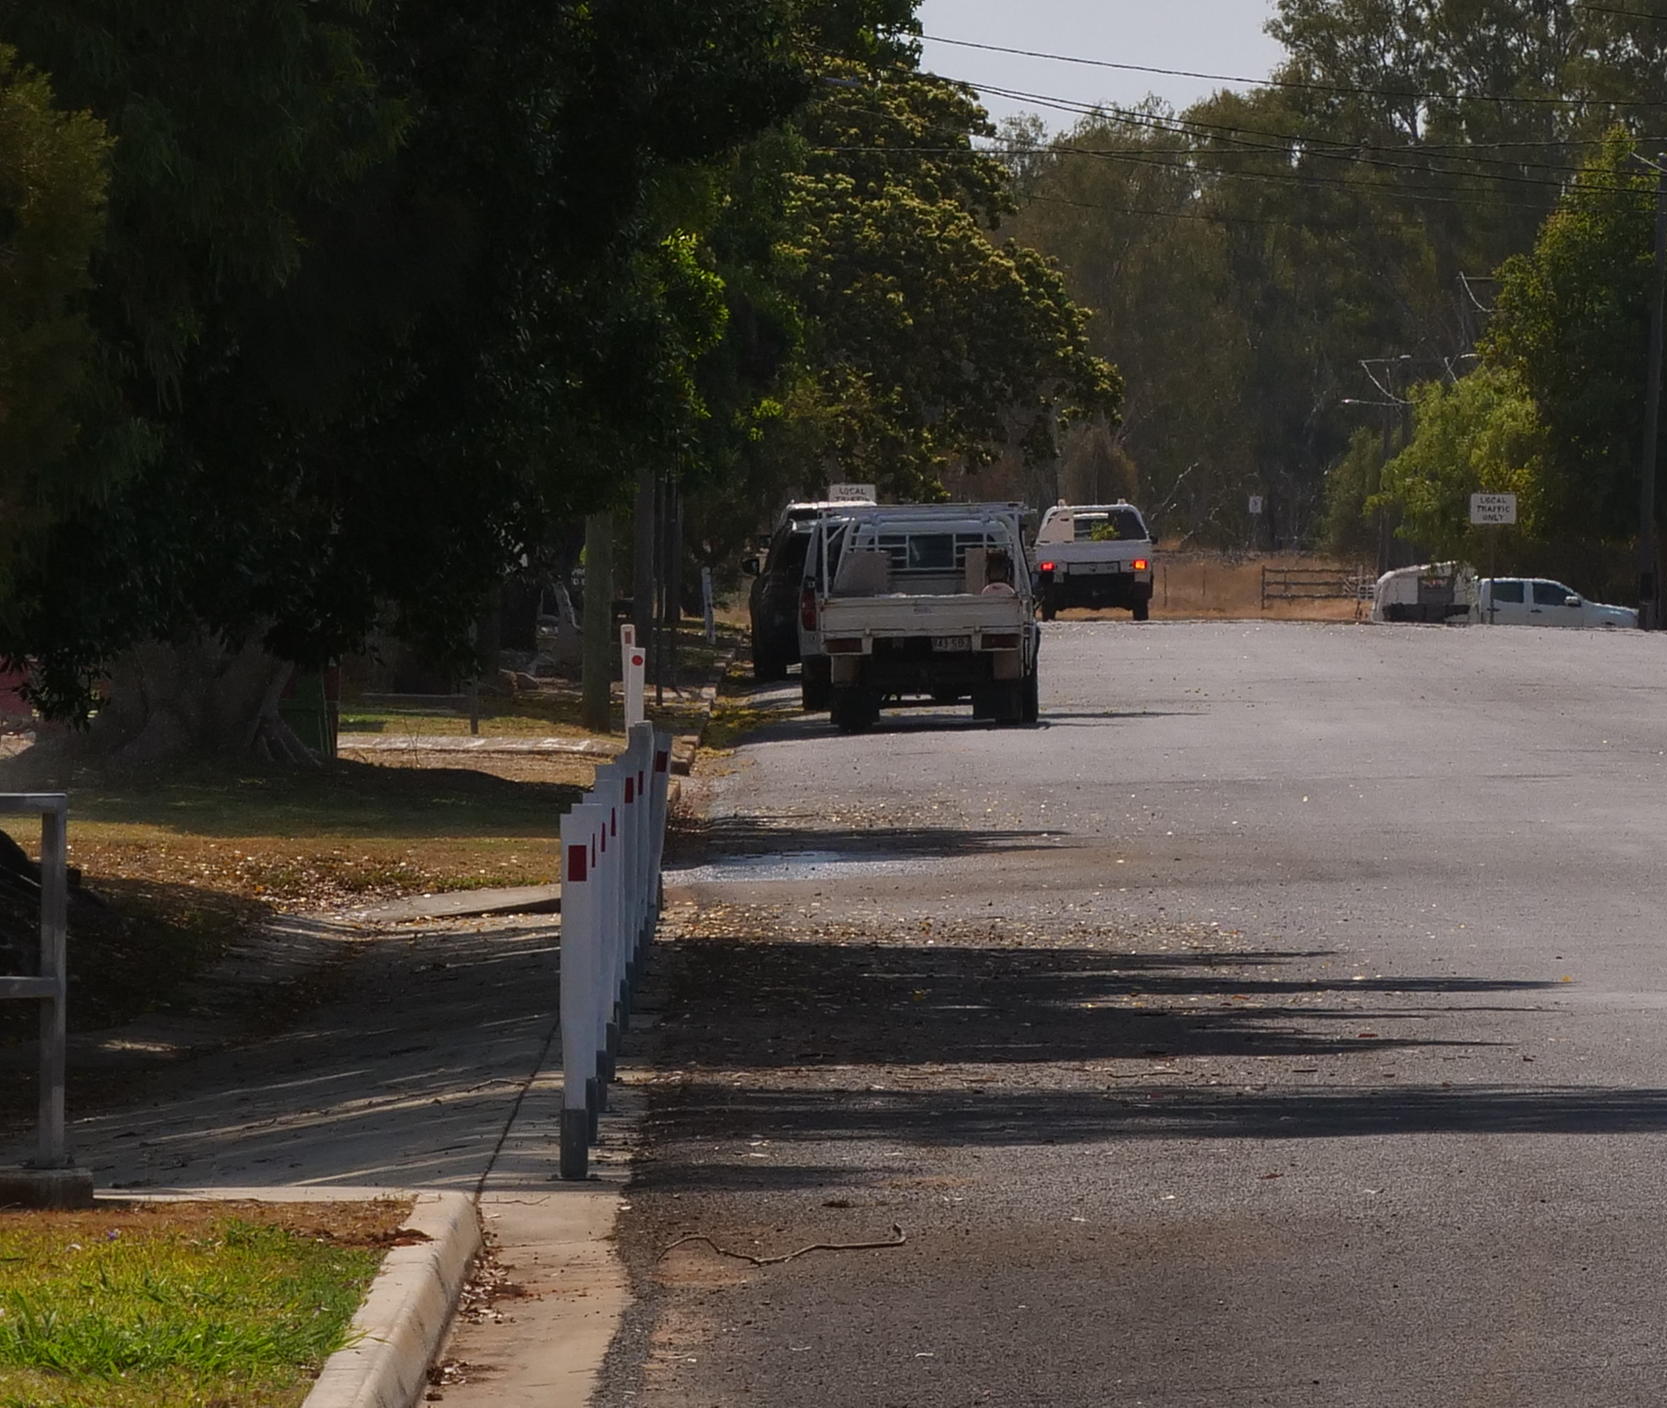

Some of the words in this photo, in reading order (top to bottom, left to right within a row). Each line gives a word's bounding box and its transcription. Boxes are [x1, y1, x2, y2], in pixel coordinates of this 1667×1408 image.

[839, 487, 866, 495] LOCAL
[1479, 496, 1507, 504] LOCAL
[1476, 505, 1511, 513] TRAFFIC
